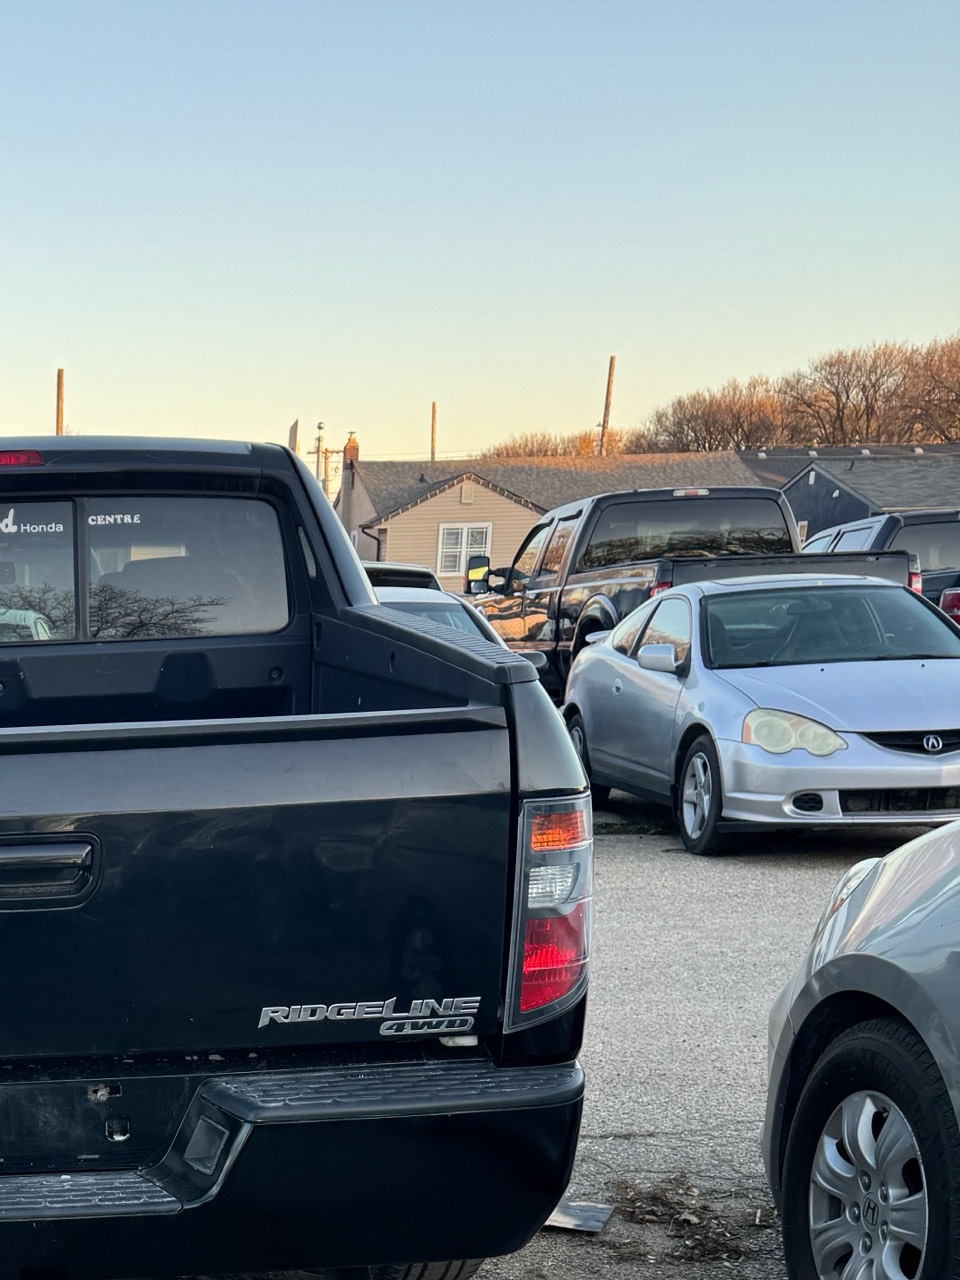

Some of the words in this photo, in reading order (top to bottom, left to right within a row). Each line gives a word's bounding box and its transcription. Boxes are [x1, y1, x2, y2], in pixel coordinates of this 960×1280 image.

[21, 522, 64, 533] Honda
[88, 514, 141, 525] CENTRE
[383, 1017, 471, 1034] 4WD
